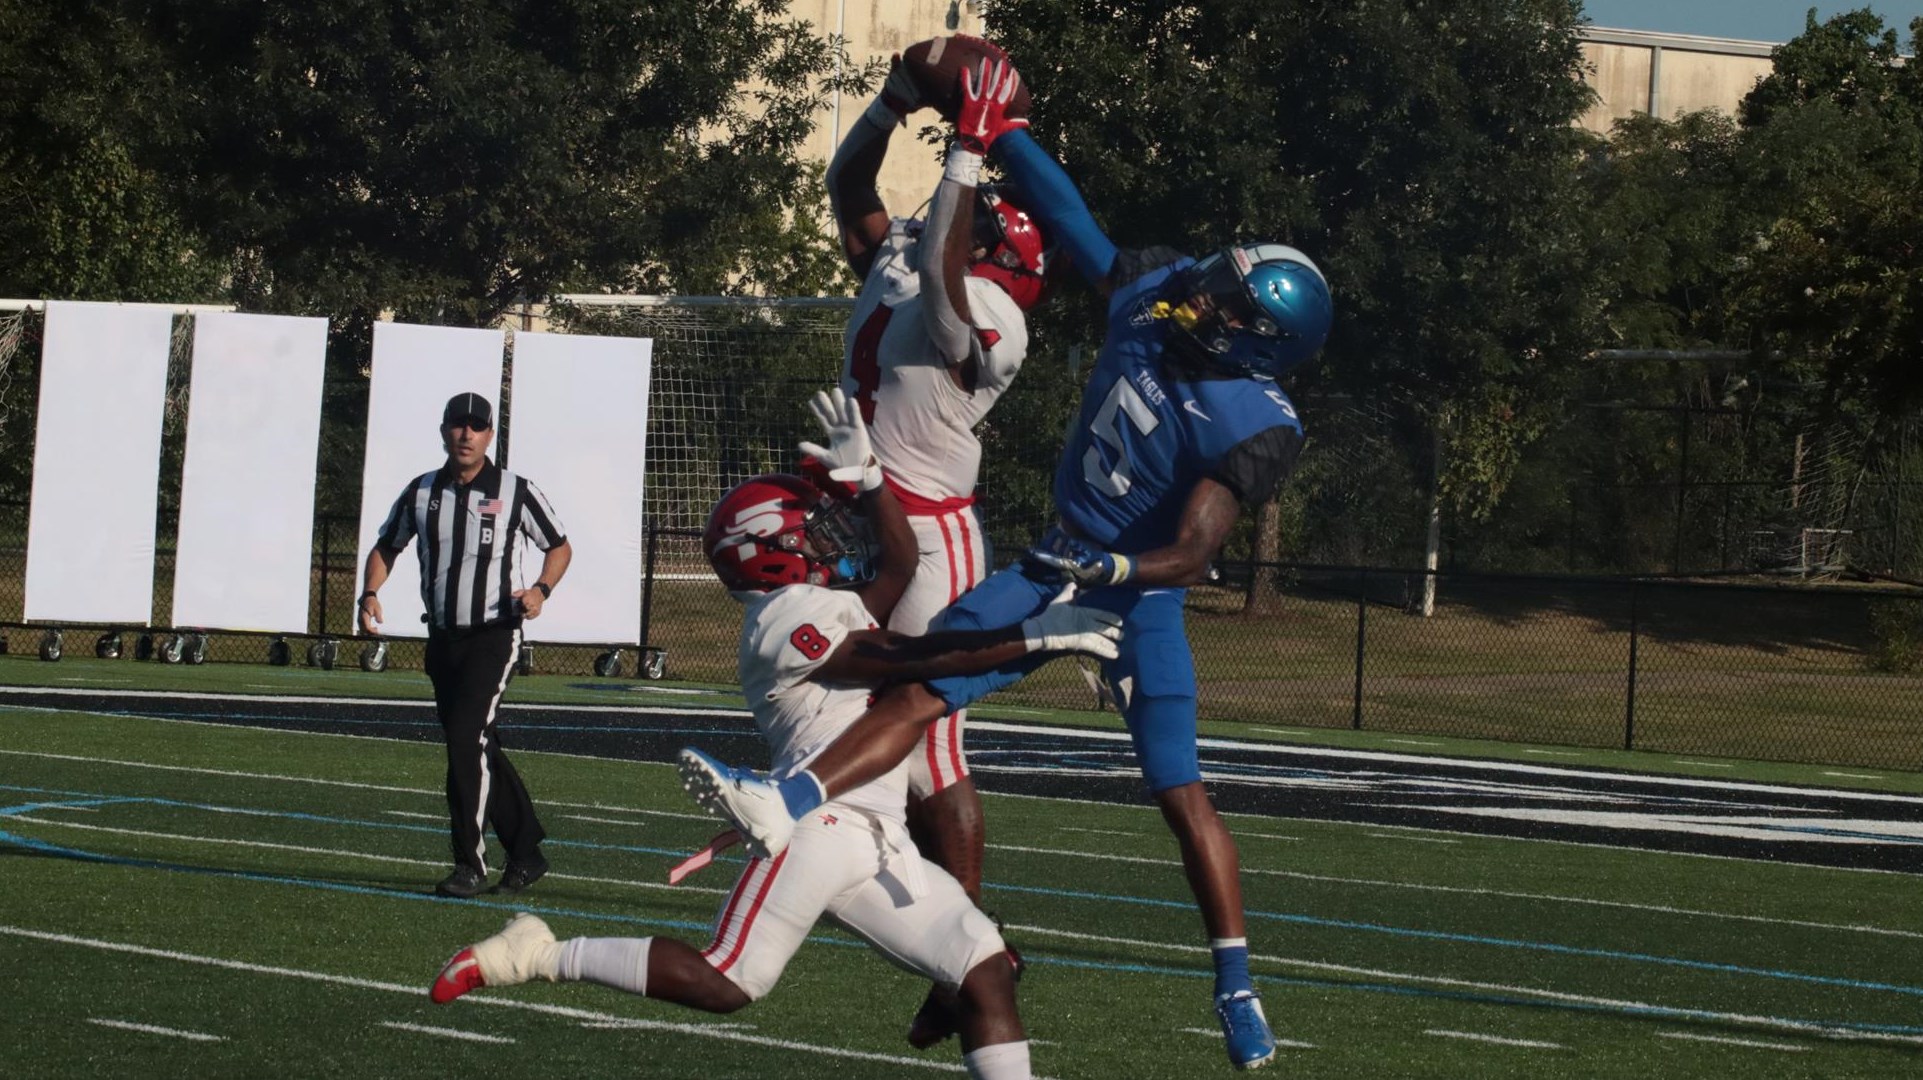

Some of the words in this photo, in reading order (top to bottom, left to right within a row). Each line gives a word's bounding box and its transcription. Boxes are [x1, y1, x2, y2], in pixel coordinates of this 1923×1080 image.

[1136, 369, 1167, 406] EAGLES
[1264, 390, 1297, 419] 5
[1082, 375, 1160, 498] 5
[429, 499, 440, 511] S
[481, 527, 493, 544] B
[790, 623, 831, 661] 8
